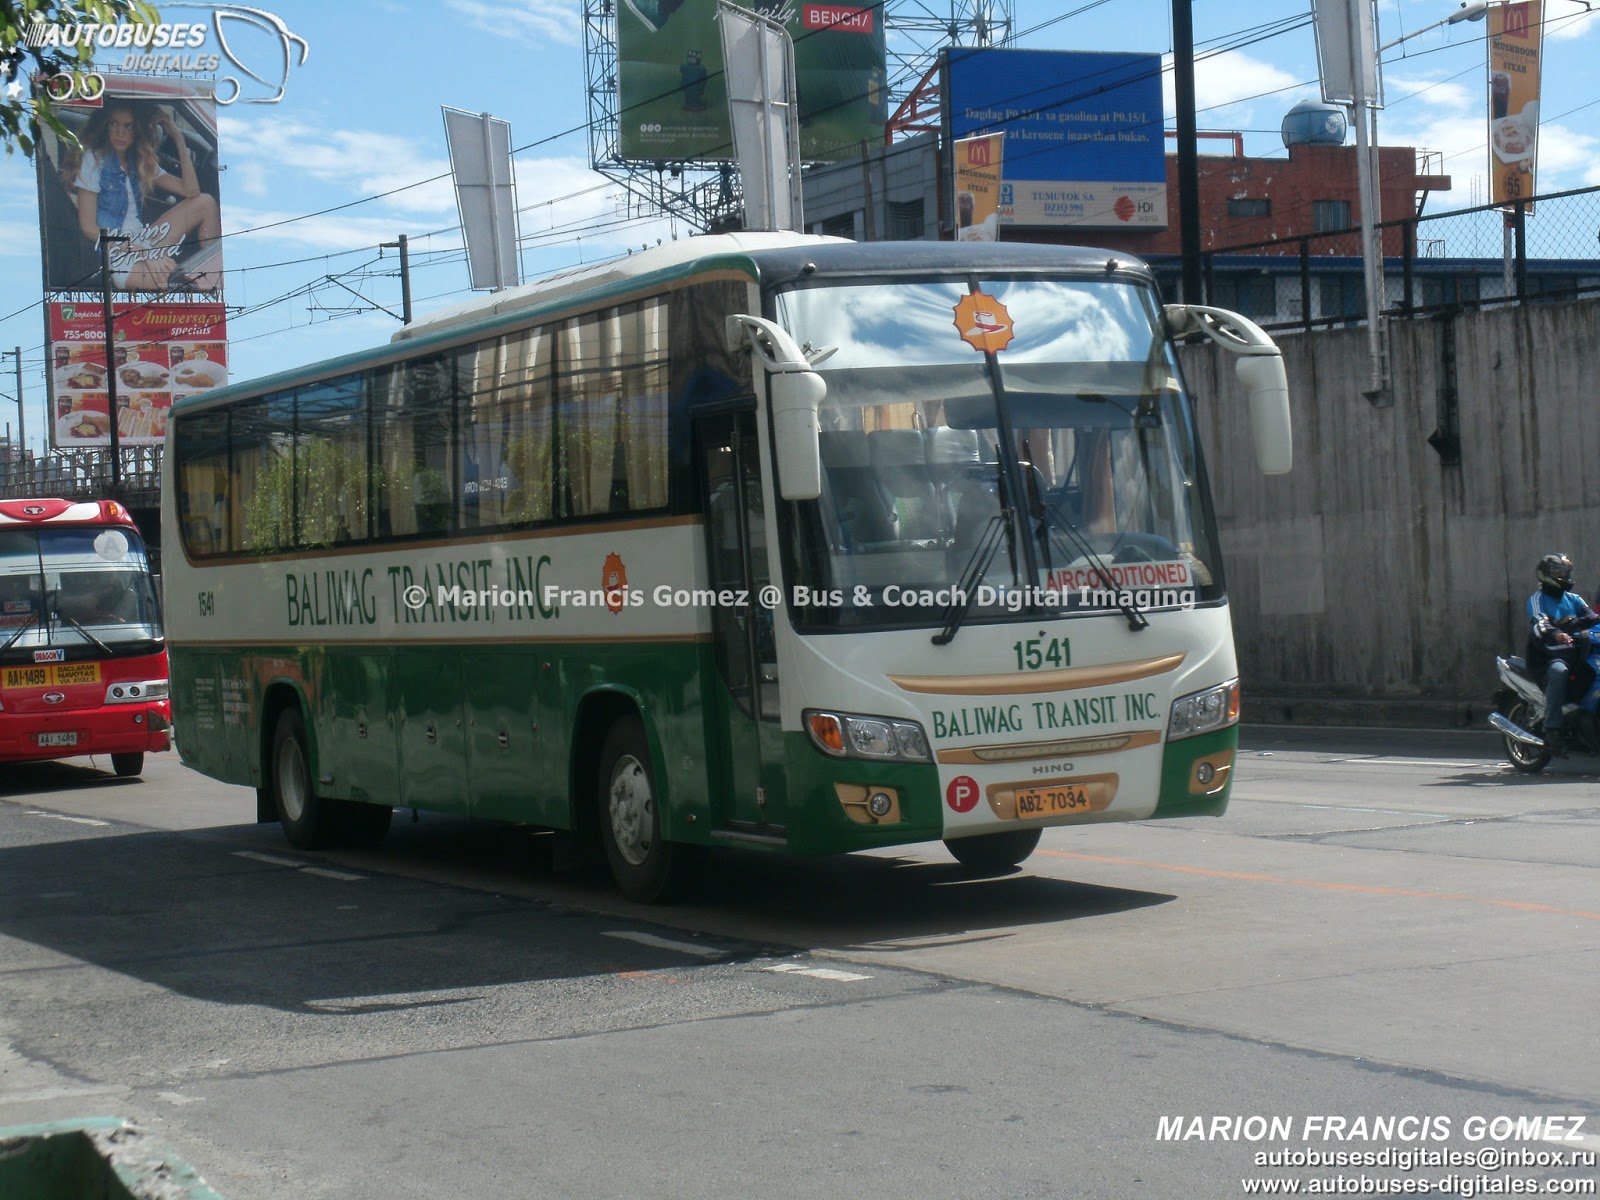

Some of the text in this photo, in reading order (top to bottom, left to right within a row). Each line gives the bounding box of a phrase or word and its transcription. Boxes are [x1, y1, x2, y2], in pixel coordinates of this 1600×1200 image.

[810, 9, 868, 27] BENCH/
[1503, 61, 1527, 73] STEAK
[966, 107, 1003, 121] Dagdag
[1046, 112, 1056, 120] sa
[1059, 111, 1098, 123] gasolina
[1100, 112, 1109, 122] at
[1010, 129, 1019, 139] at
[1022, 129, 1064, 140] kerosene
[1118, 131, 1149, 142] bukas.
[1032, 192, 1094, 201] TUMUTOK SA
[1137, 201, 1154, 213] HDI
[132, 310, 221, 328] Anniversary
[286, 567, 376, 626] BALIWAG
[505, 554, 560, 621] INC.
[198, 590, 215, 616] 1541
[1013, 637, 1072, 670] 1541
[57, 664, 95, 672] BACLARAN
[58, 671, 95, 679] NAVOTAS
[8, 669, 46, 686] AAI-1489
[932, 704, 1023, 739] BALIWAG
[1124, 692, 1161, 722] INC.
[1032, 762, 1075, 775] HINO
[956, 786, 971, 807] P
